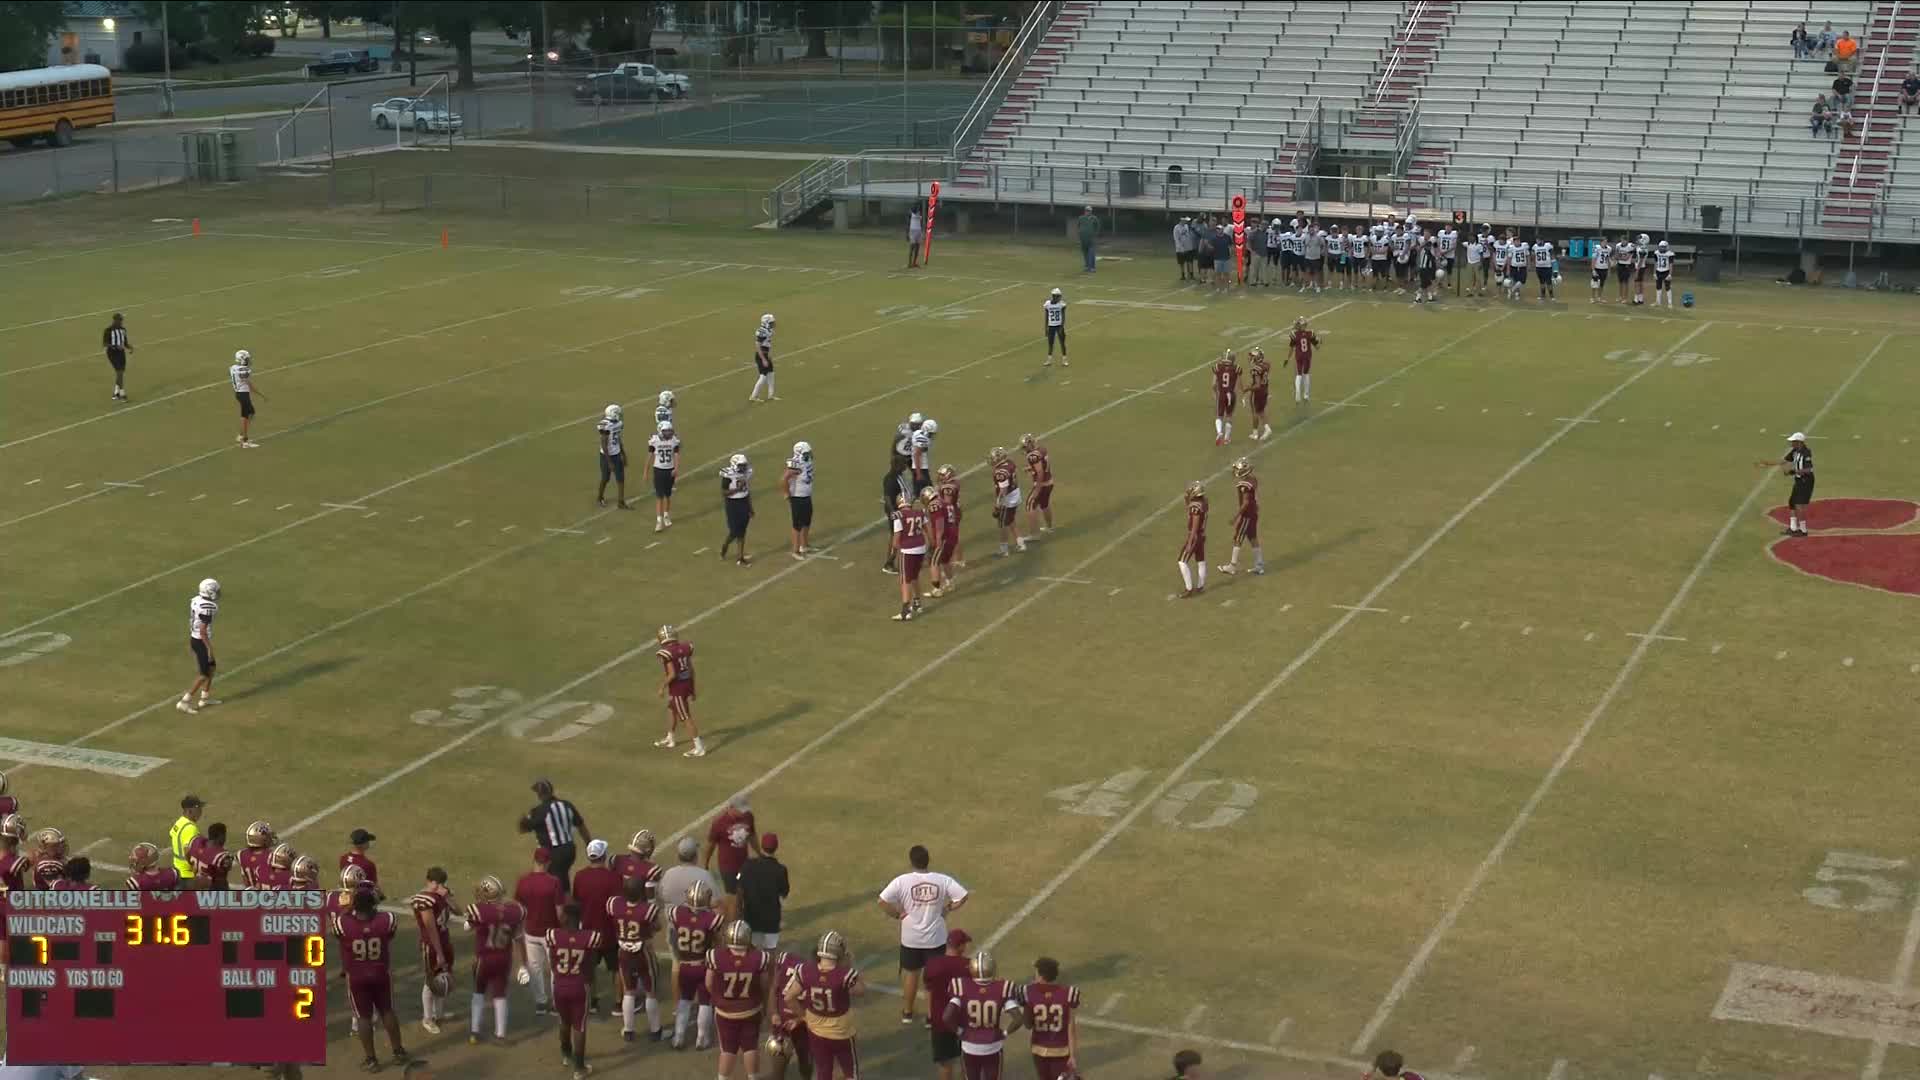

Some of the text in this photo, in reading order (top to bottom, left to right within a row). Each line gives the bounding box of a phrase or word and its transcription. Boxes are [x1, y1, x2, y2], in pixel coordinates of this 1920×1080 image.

[1049, 310, 1061, 322] 28
[1300, 338, 1308, 353] 8
[1222, 372, 1230, 388] 9
[658, 449, 673, 464] 35
[906, 517, 923, 537] 73
[410, 686, 615, 743] 30
[617, 919, 640, 940] 12
[677, 926, 706, 954] 22
[352, 936, 382, 962] 98
[556, 948, 585, 975] 37
[723, 971, 753, 999] 77
[810, 986, 837, 1013] 51
[967, 999, 999, 1029] 90
[1033, 1004, 1065, 1033] 23
